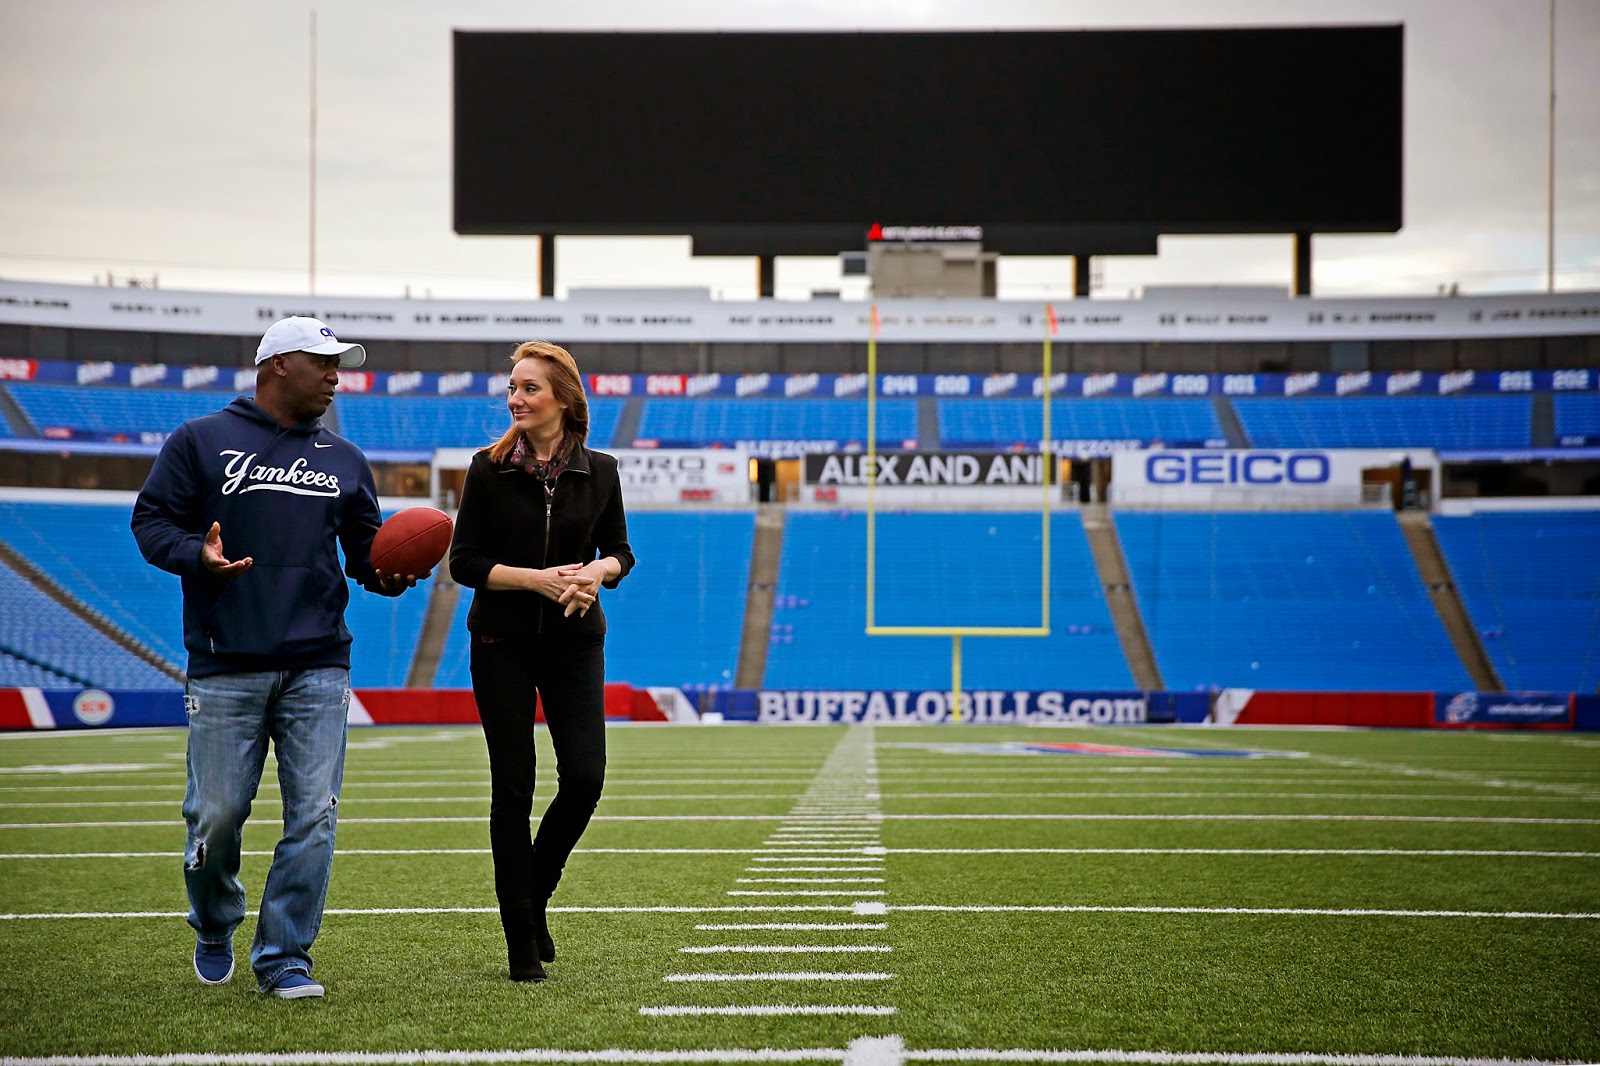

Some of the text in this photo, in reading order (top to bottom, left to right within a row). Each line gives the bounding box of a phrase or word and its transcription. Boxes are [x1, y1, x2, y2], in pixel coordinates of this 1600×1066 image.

[220, 449, 340, 496] Yankees
[818, 455, 899, 485] ALEX
[905, 455, 981, 485] AND
[1145, 454, 1330, 484] GEICO
[758, 691, 1147, 723] BUFFALOBILLS.com
